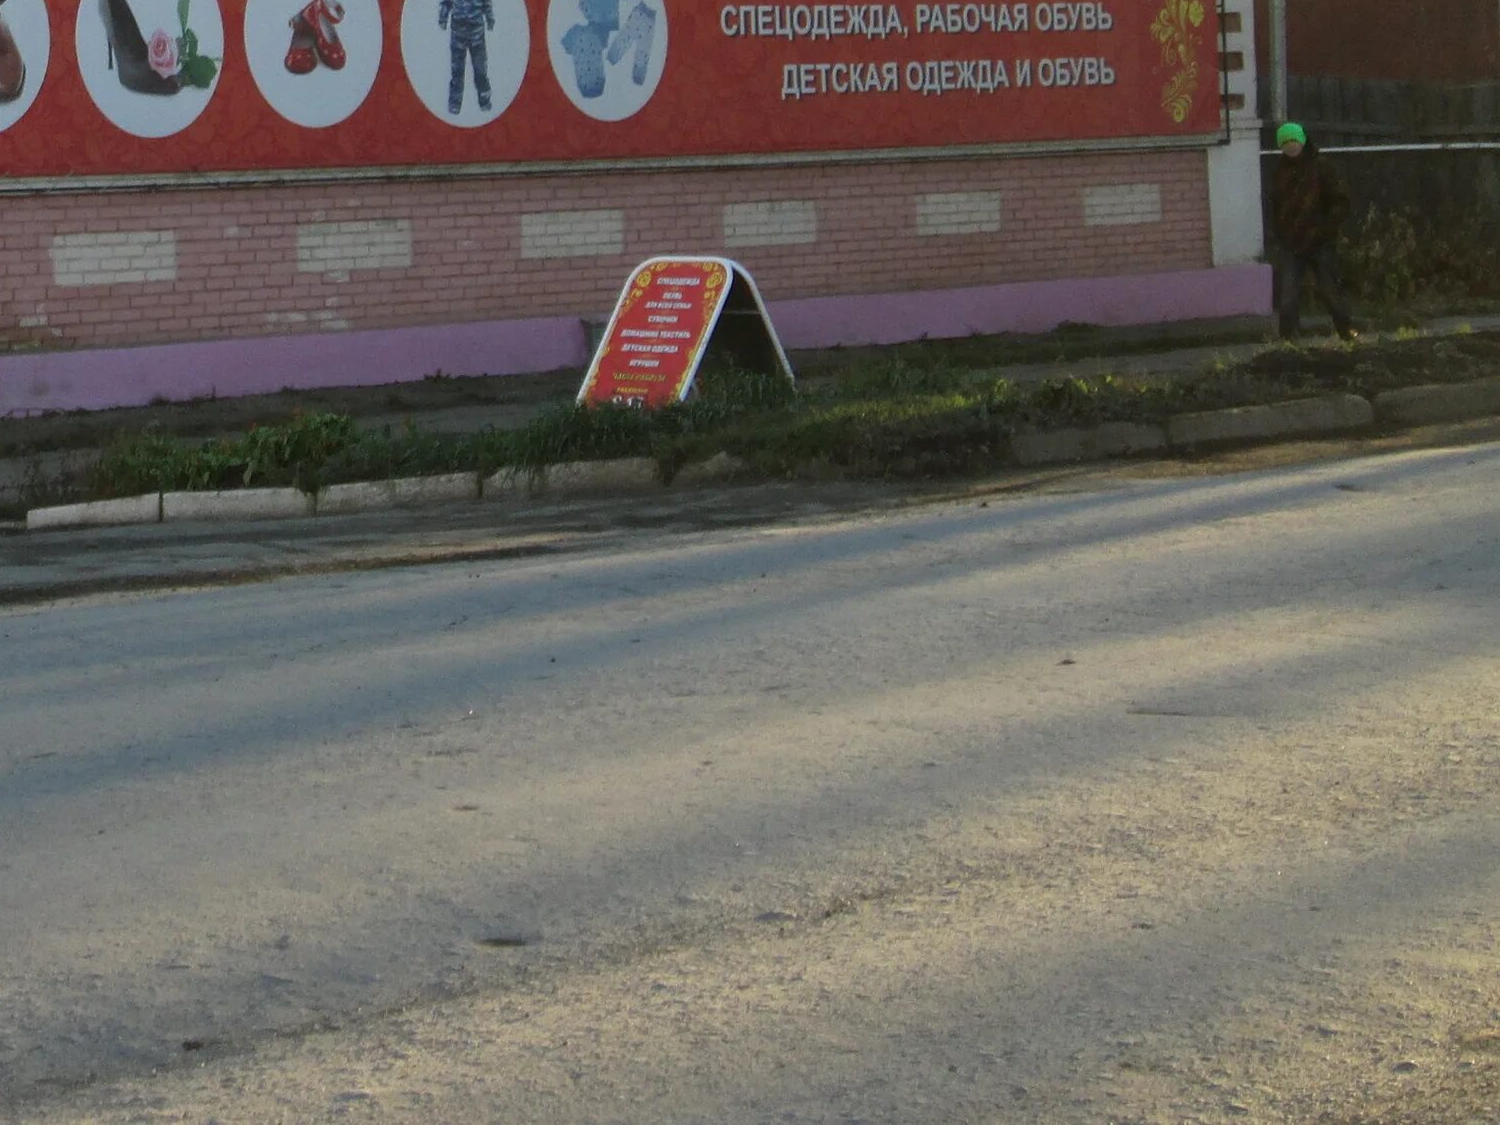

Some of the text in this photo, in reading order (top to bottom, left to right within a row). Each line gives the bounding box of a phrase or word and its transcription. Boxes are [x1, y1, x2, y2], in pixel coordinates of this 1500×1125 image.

[720, 1, 1113, 40] СПЕЦОДЕЖДА, РАБОЧАЯ ОБУВЬ
[780, 56, 1116, 100] ДЕТСКАЯ ОДЕЖДА И ОБУВЬ
